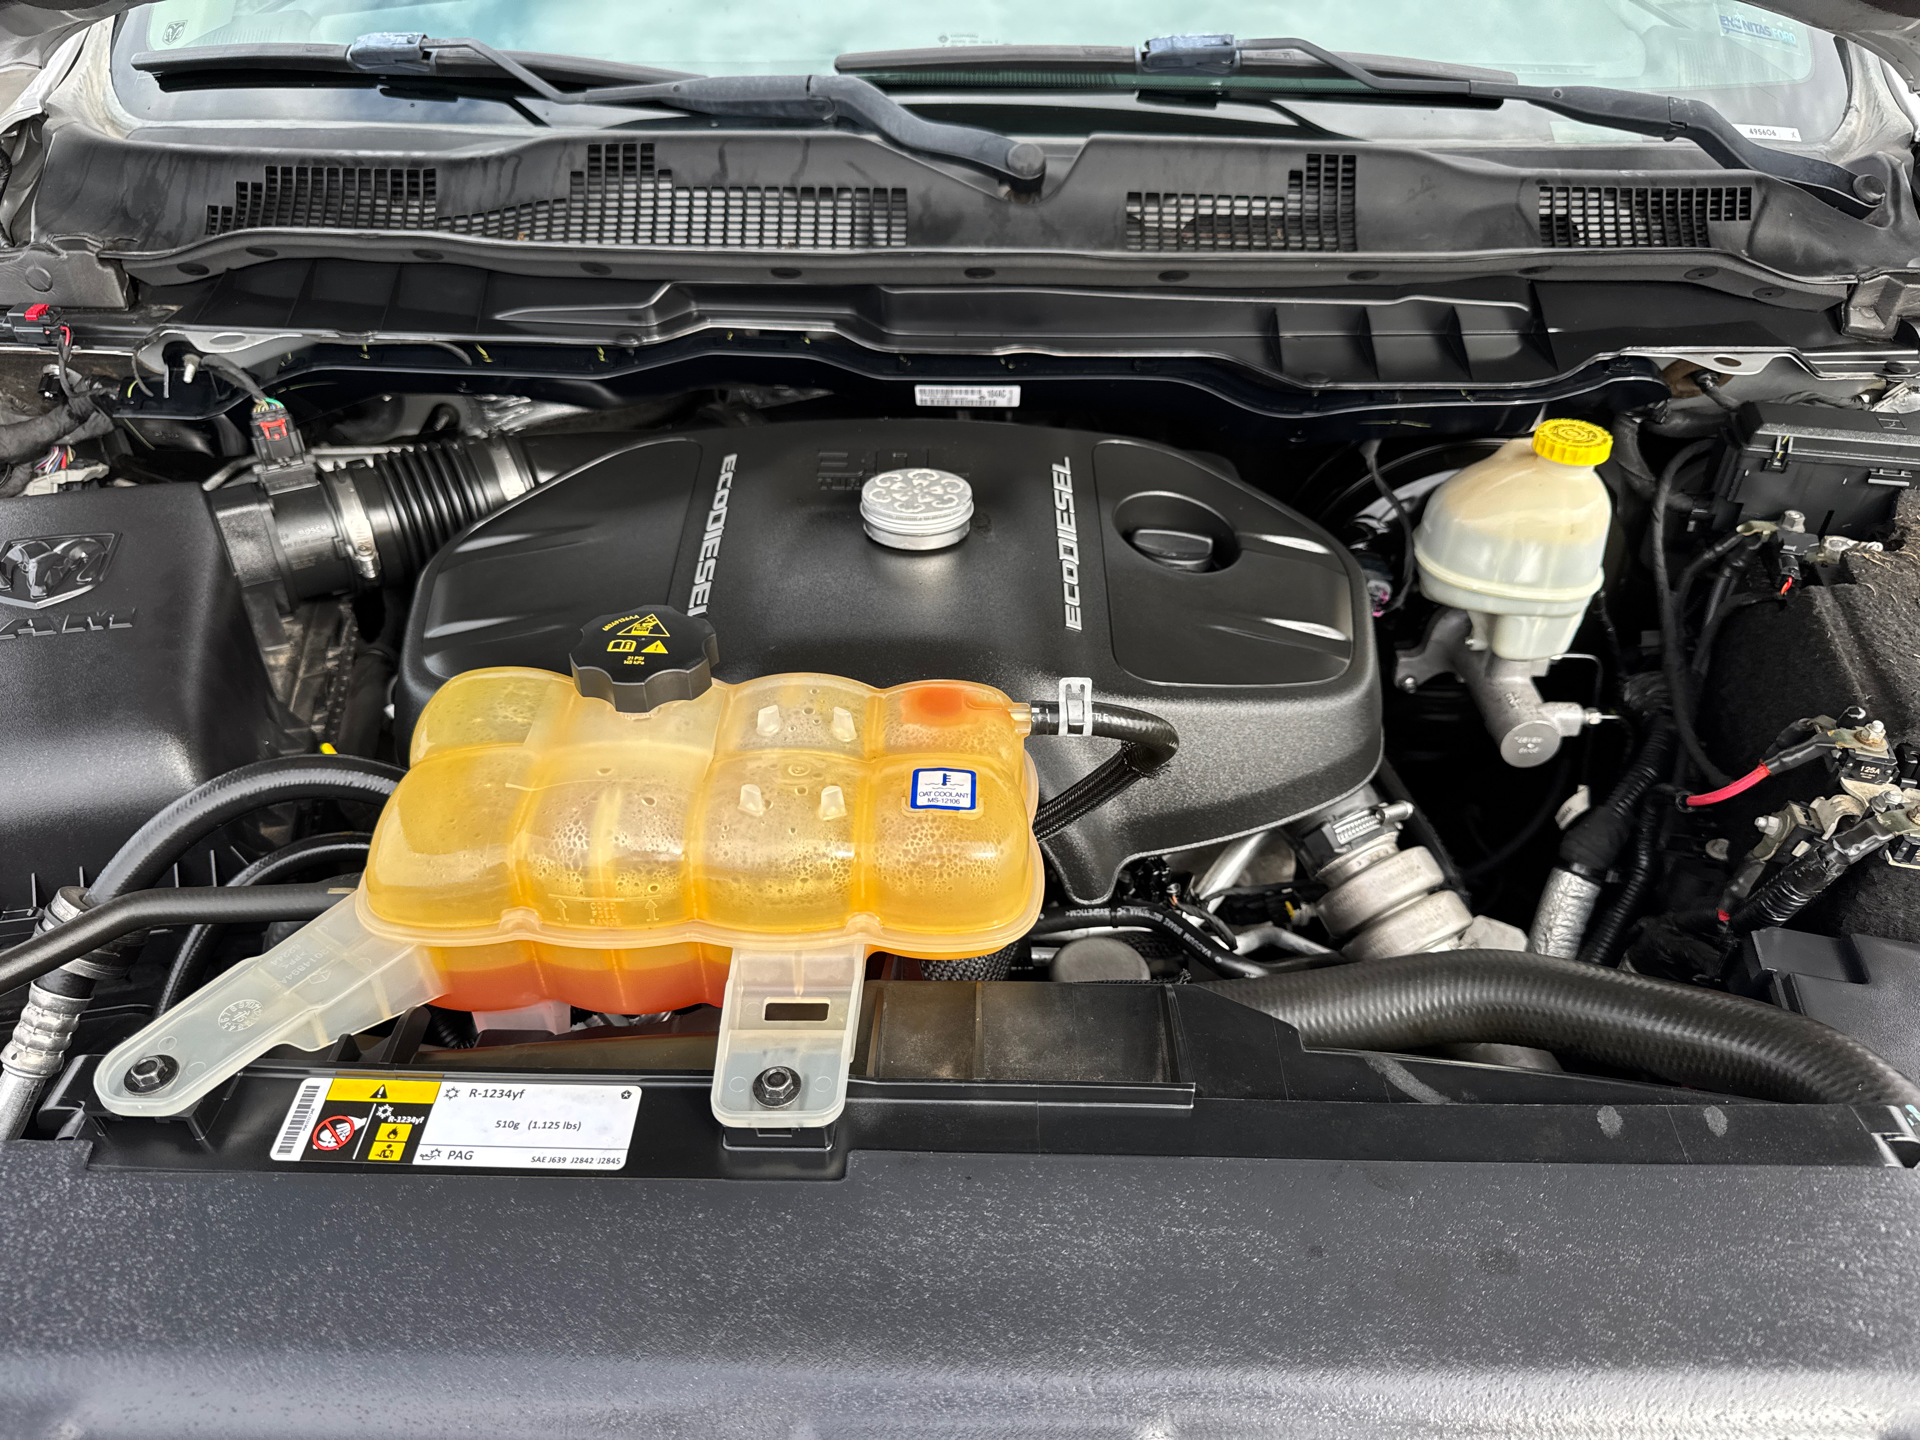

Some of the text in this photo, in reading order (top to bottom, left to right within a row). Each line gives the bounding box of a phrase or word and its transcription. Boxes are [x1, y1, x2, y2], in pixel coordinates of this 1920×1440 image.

[1771, 27, 1797, 44] FORD
[1051, 456, 1083, 632] ECODIESEL
[1860, 765, 1880, 775] 125A
[934, 790, 969, 799] COOLANT
[590, 902, 616, 910] COLD
[469, 1088, 526, 1099] R-1234yf
[387, 1115, 425, 1125] R-1234yf
[495, 1120, 582, 1132] 510g (1.125 lbs)
[447, 1150, 621, 1165] PAG SAE J639 J2842 J2845
